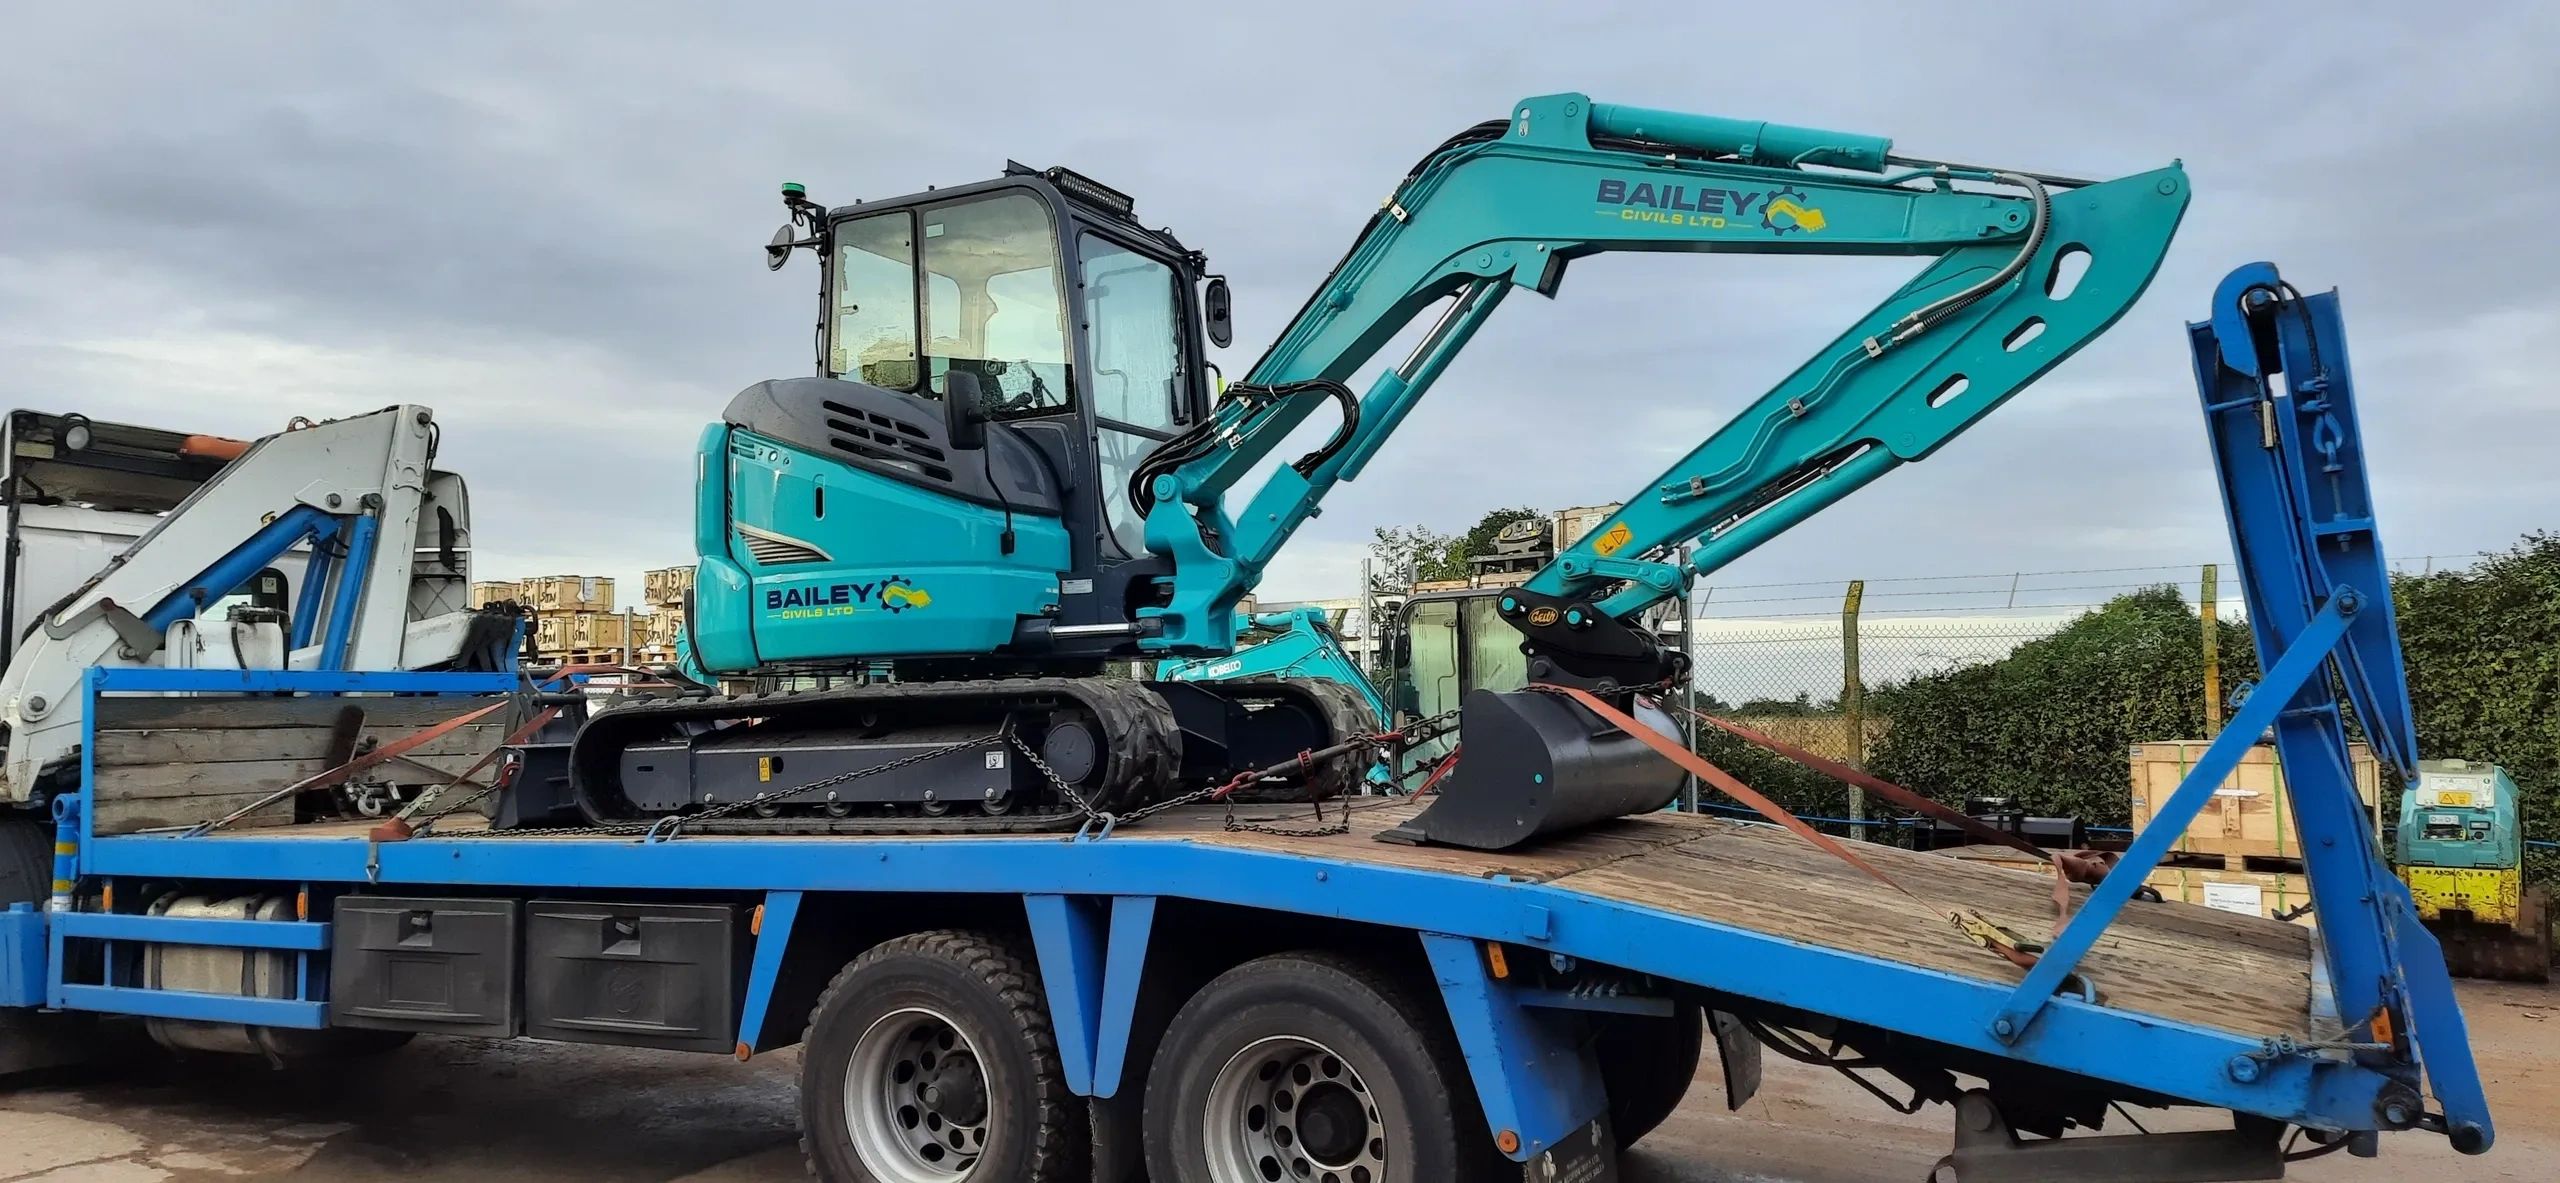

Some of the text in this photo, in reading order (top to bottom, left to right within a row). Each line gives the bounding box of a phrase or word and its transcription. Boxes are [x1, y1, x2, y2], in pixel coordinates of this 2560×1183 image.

[1596, 179, 1761, 216] BAILEY
[1620, 209, 1727, 229] CIVILS LTD
[766, 583, 875, 610] BAILEY
[782, 606, 854, 620] CIVILS LTD
[1207, 660, 1242, 678] KOBELCO
